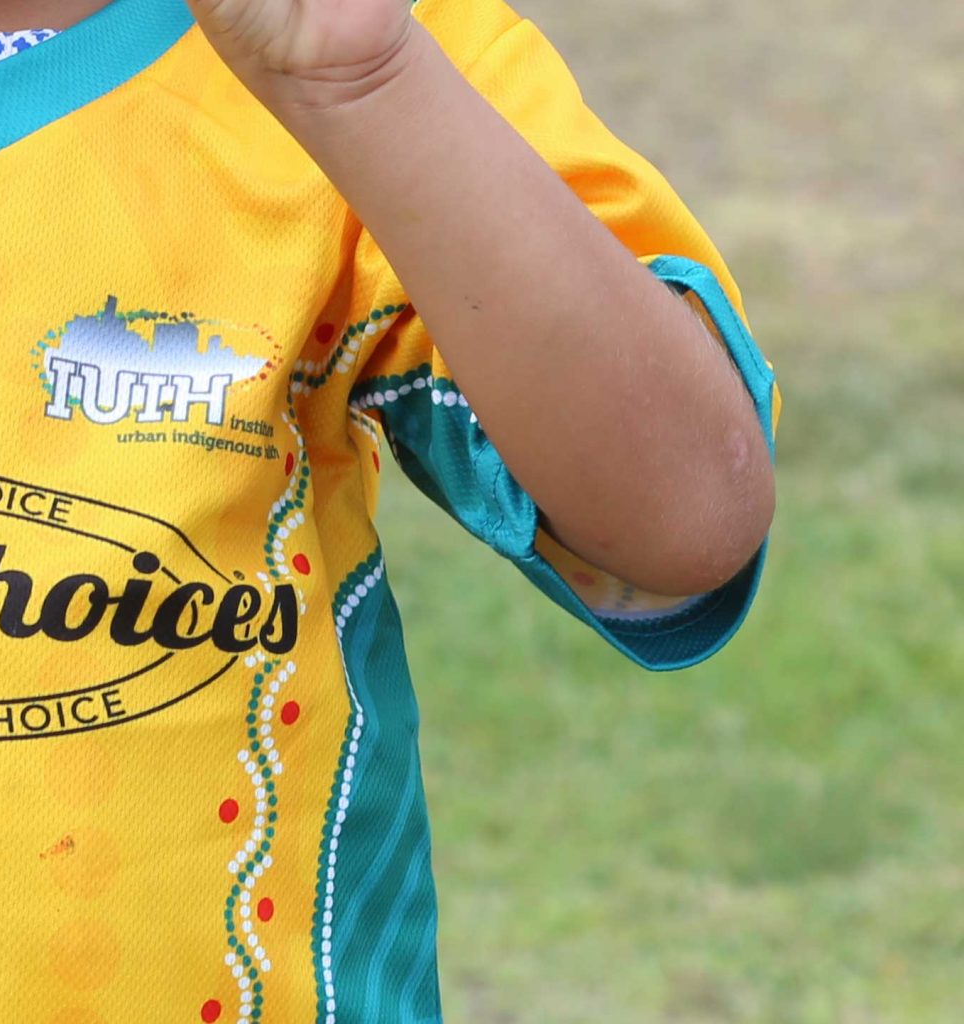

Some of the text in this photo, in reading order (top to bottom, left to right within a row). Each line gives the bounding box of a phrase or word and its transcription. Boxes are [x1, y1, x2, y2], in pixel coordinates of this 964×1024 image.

[43, 356, 234, 426] IUIH
[116, 431, 168, 444] urban
[172, 428, 263, 459] indigenous
